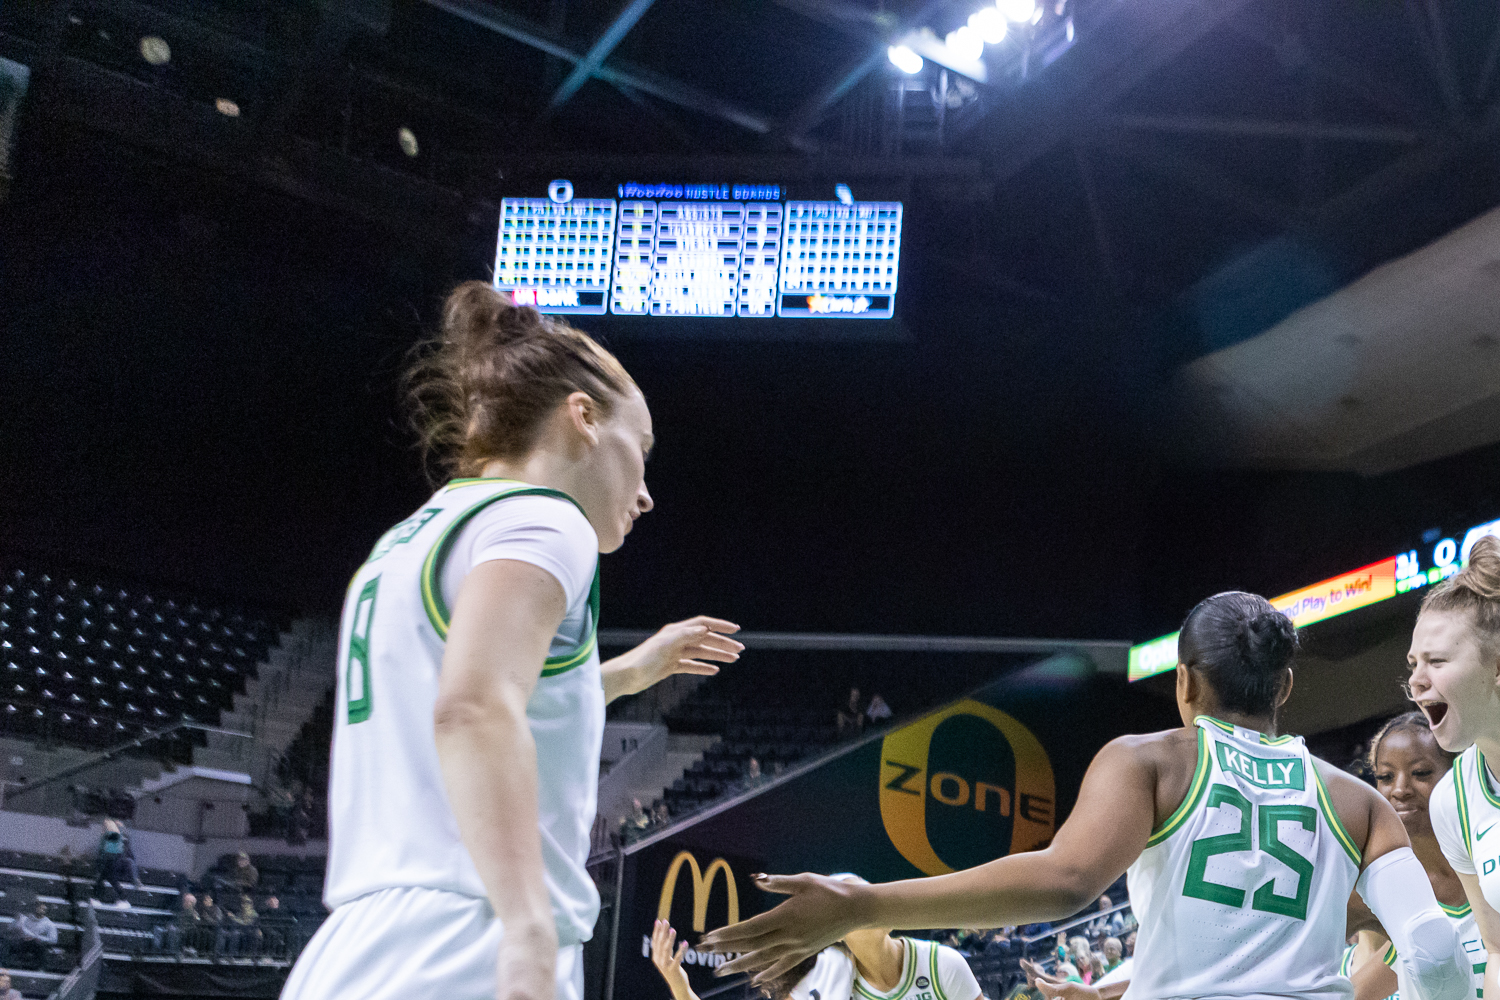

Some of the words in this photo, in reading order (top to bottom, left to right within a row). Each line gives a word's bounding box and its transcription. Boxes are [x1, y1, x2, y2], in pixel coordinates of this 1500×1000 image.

[732, 184, 780, 200] BOARDS
[1302, 592, 1327, 616] Play
[1330, 588, 1342, 605] to
[1345, 574, 1373, 599] Win!
[1223, 746, 1296, 786] KELLY
[1182, 784, 1318, 921] 25
